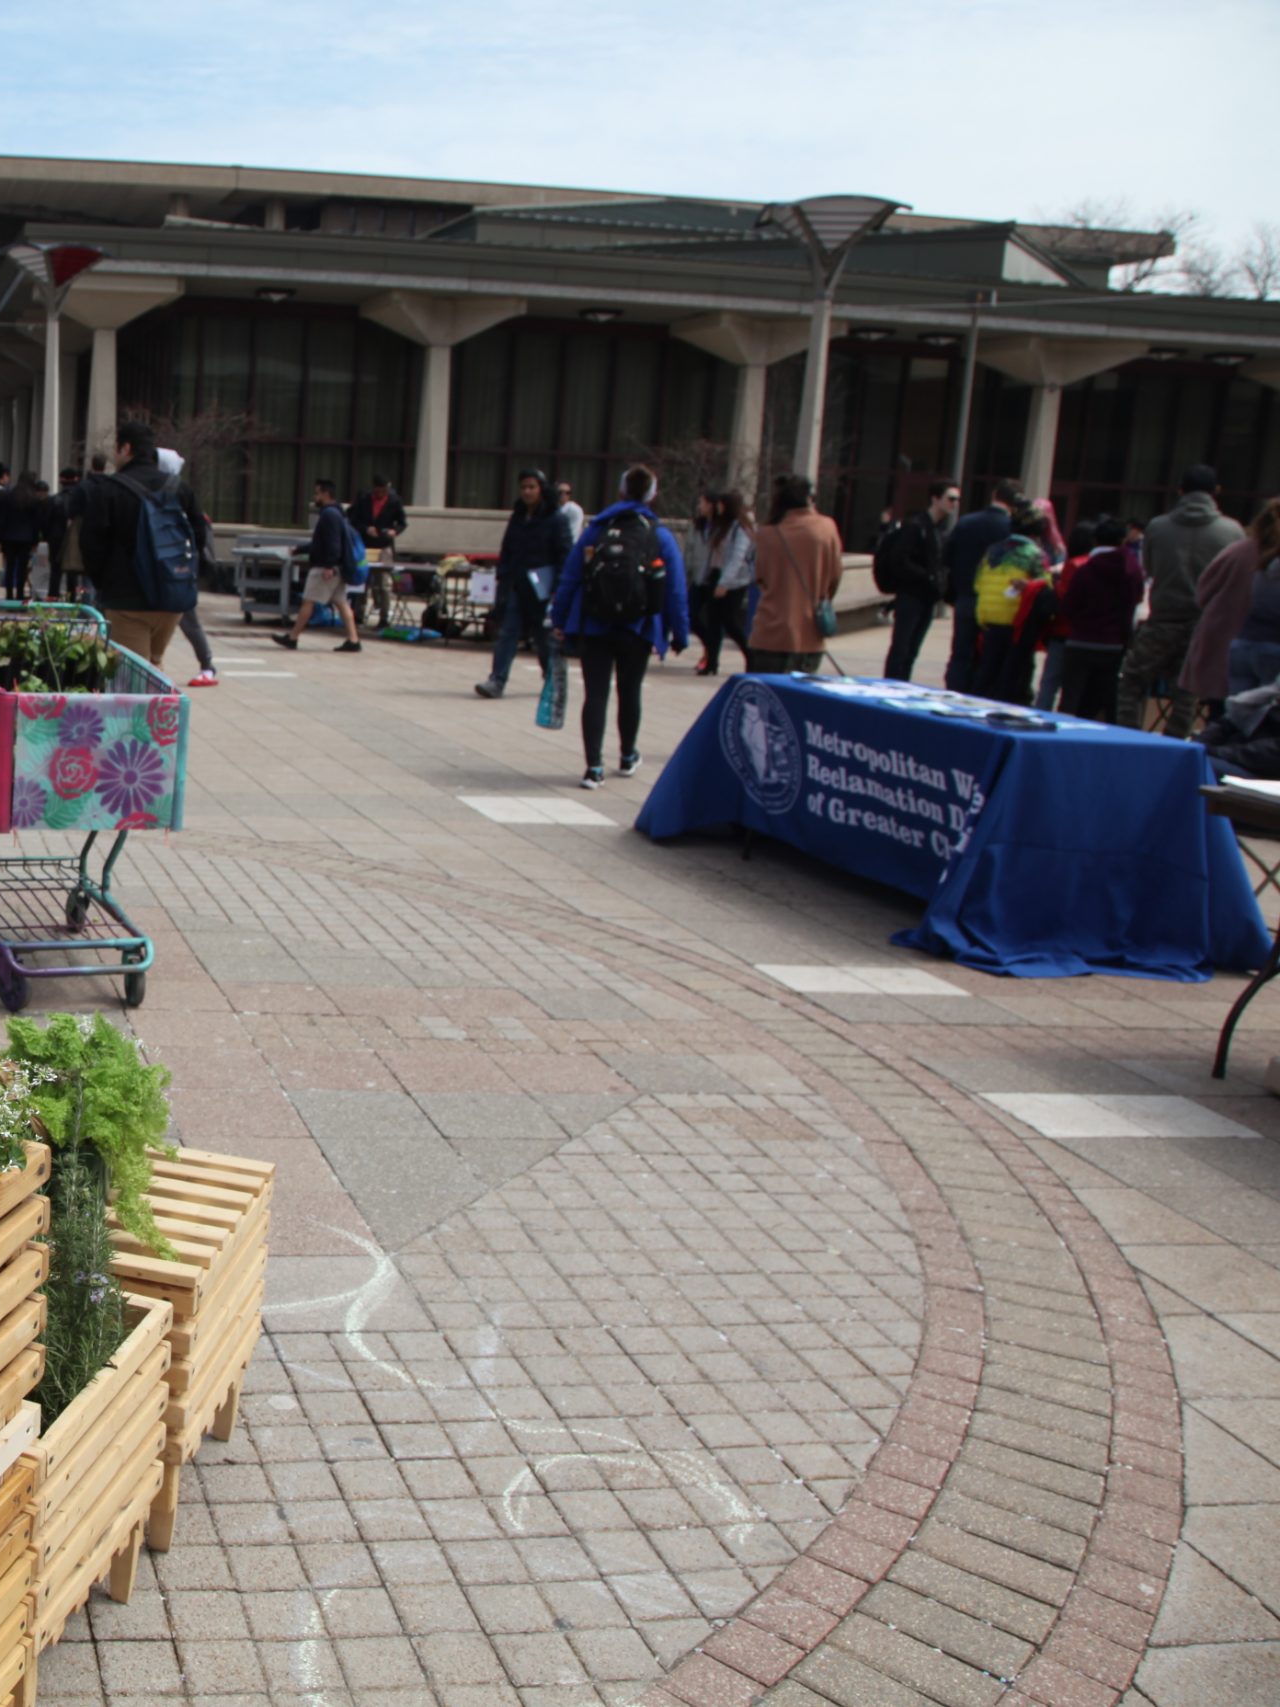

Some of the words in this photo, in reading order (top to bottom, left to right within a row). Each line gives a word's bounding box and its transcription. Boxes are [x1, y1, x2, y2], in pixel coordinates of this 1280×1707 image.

[805, 720, 947, 791] Metropolitan
[807, 753, 944, 825] Reclamation
[807, 792, 825, 817] of
[828, 797, 924, 849] Greater
